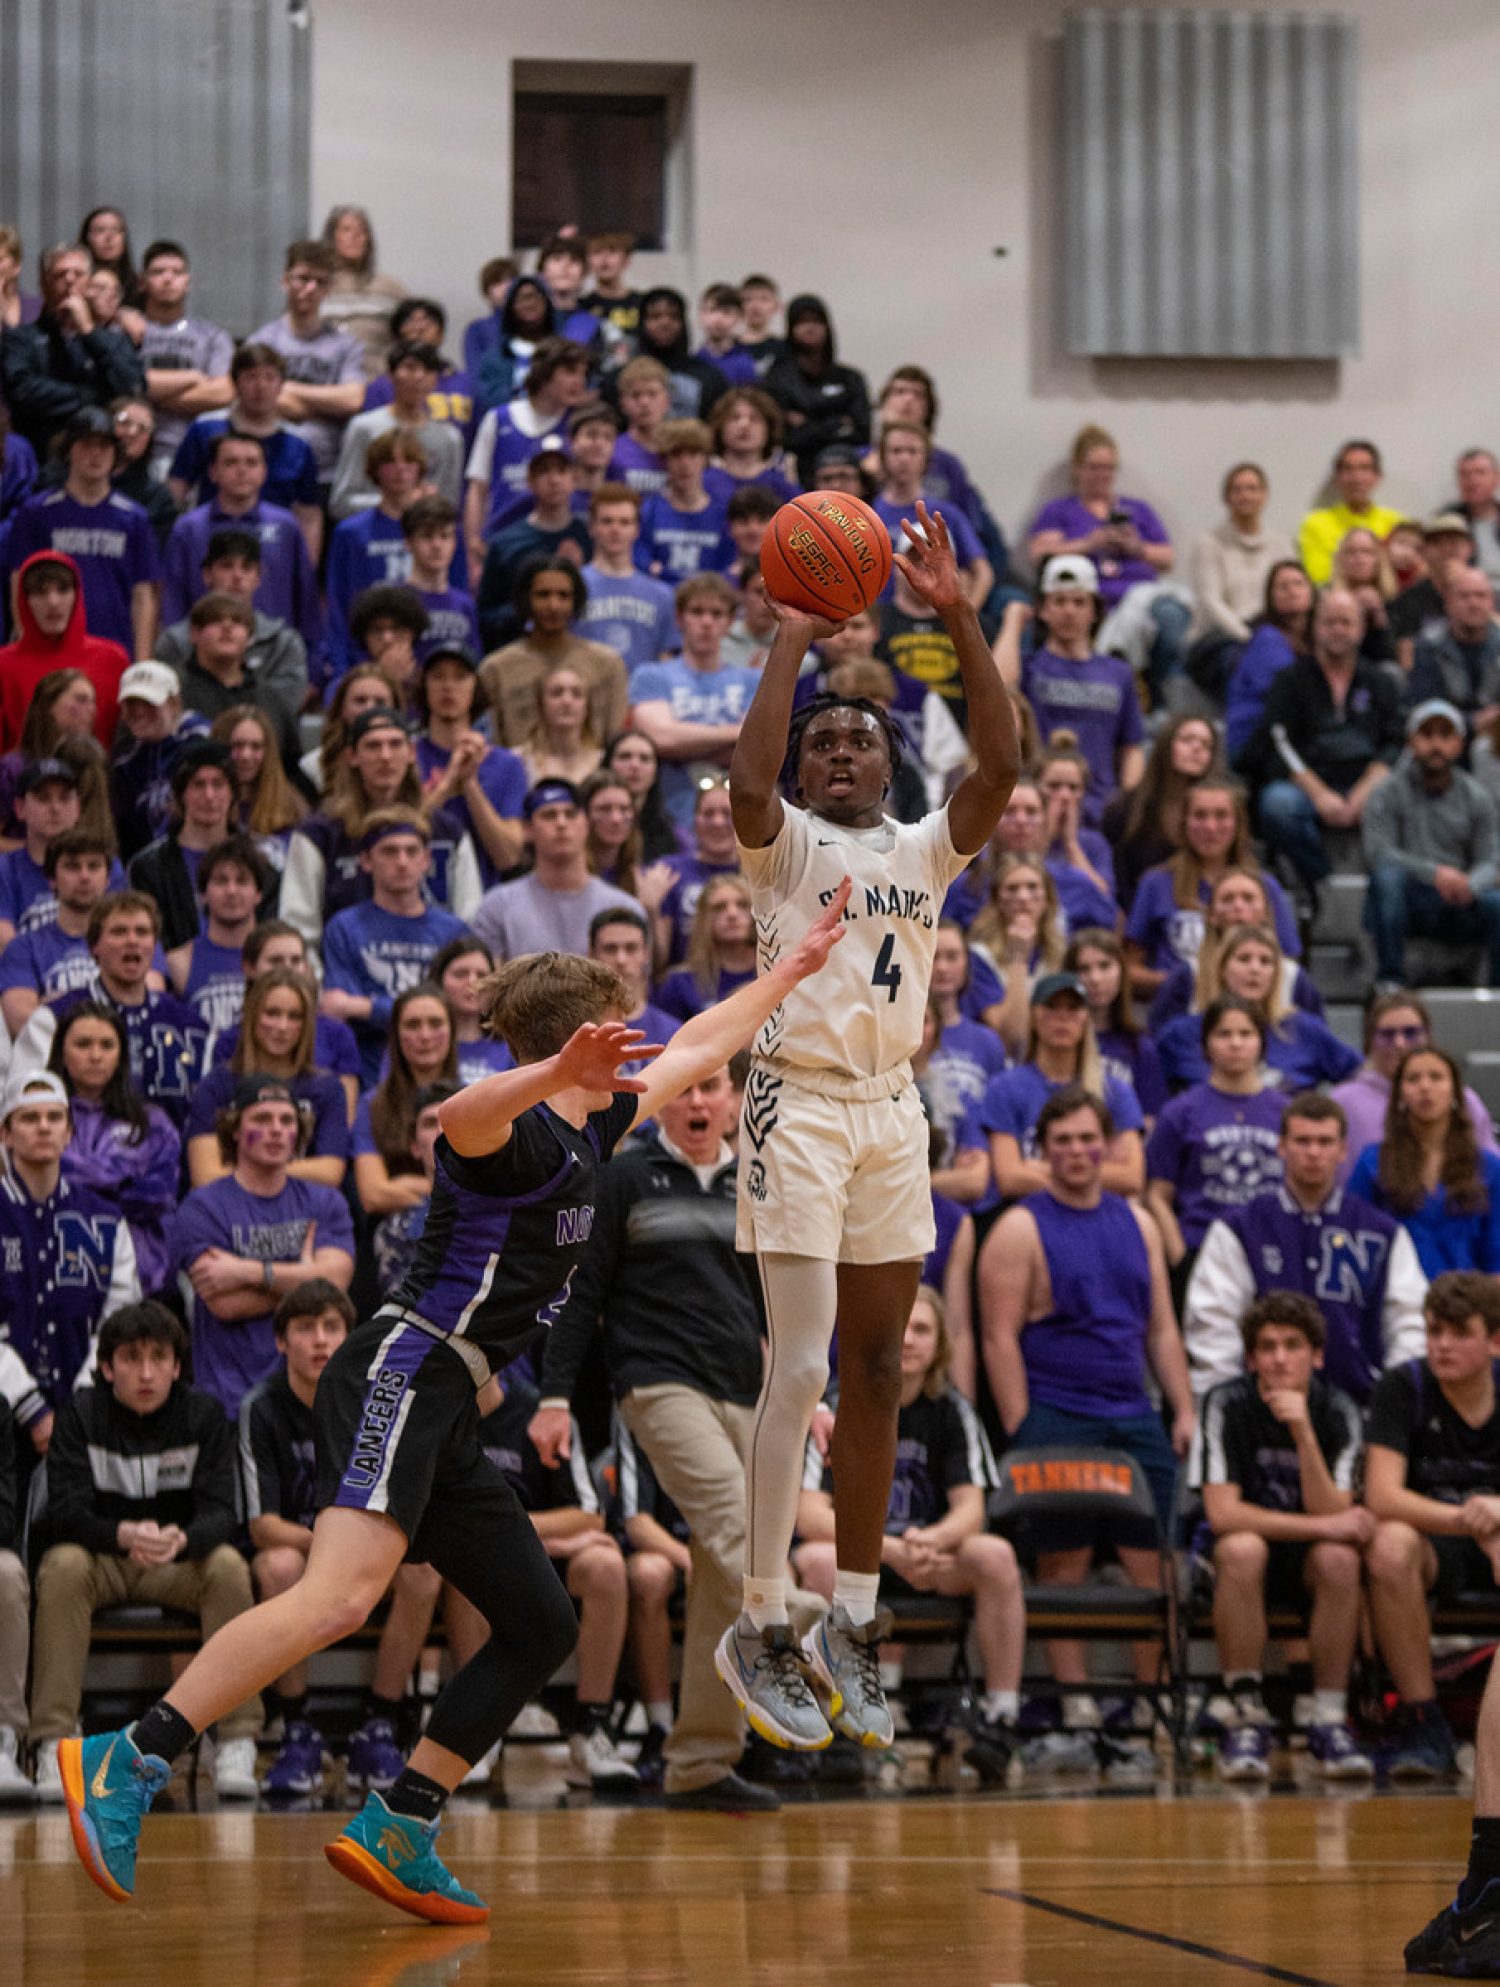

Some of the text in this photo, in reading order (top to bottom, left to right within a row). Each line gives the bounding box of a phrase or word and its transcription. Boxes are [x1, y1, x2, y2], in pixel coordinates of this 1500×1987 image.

[793, 521, 845, 585] LEGACY
[812, 499, 878, 575] SPALDING
[871, 932, 902, 1003] 4
[53, 1210, 118, 1293] N
[1316, 1226, 1388, 1308] N
[343, 1367, 409, 1488] LANCERS
